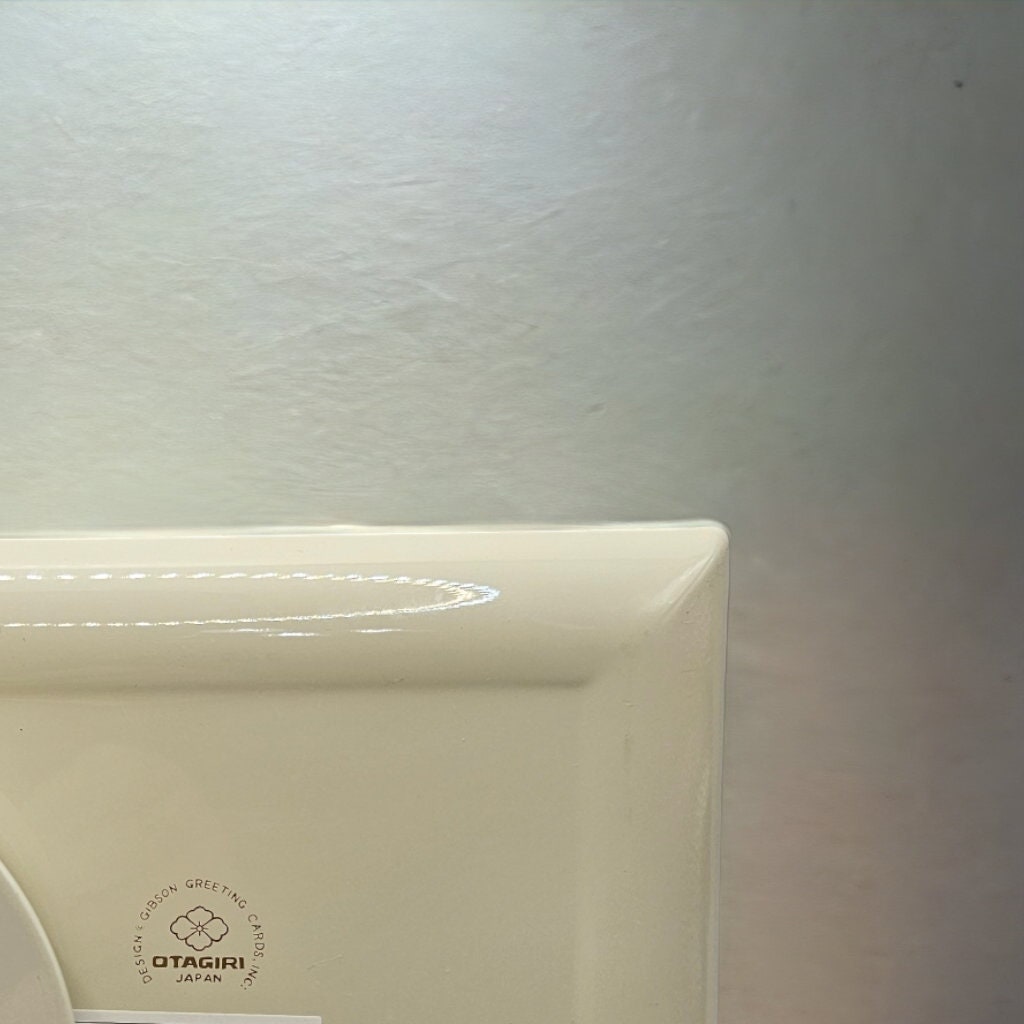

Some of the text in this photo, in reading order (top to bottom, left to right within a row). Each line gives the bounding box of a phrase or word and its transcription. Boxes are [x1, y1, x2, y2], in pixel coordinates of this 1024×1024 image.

[140, 883, 178, 921] GIBSON
[185, 878, 247, 909] GREETING
[133, 935, 152, 984] DESIGN
[152, 955, 245, 970] OTAGIRI
[176, 973, 222, 983] JAPAN
